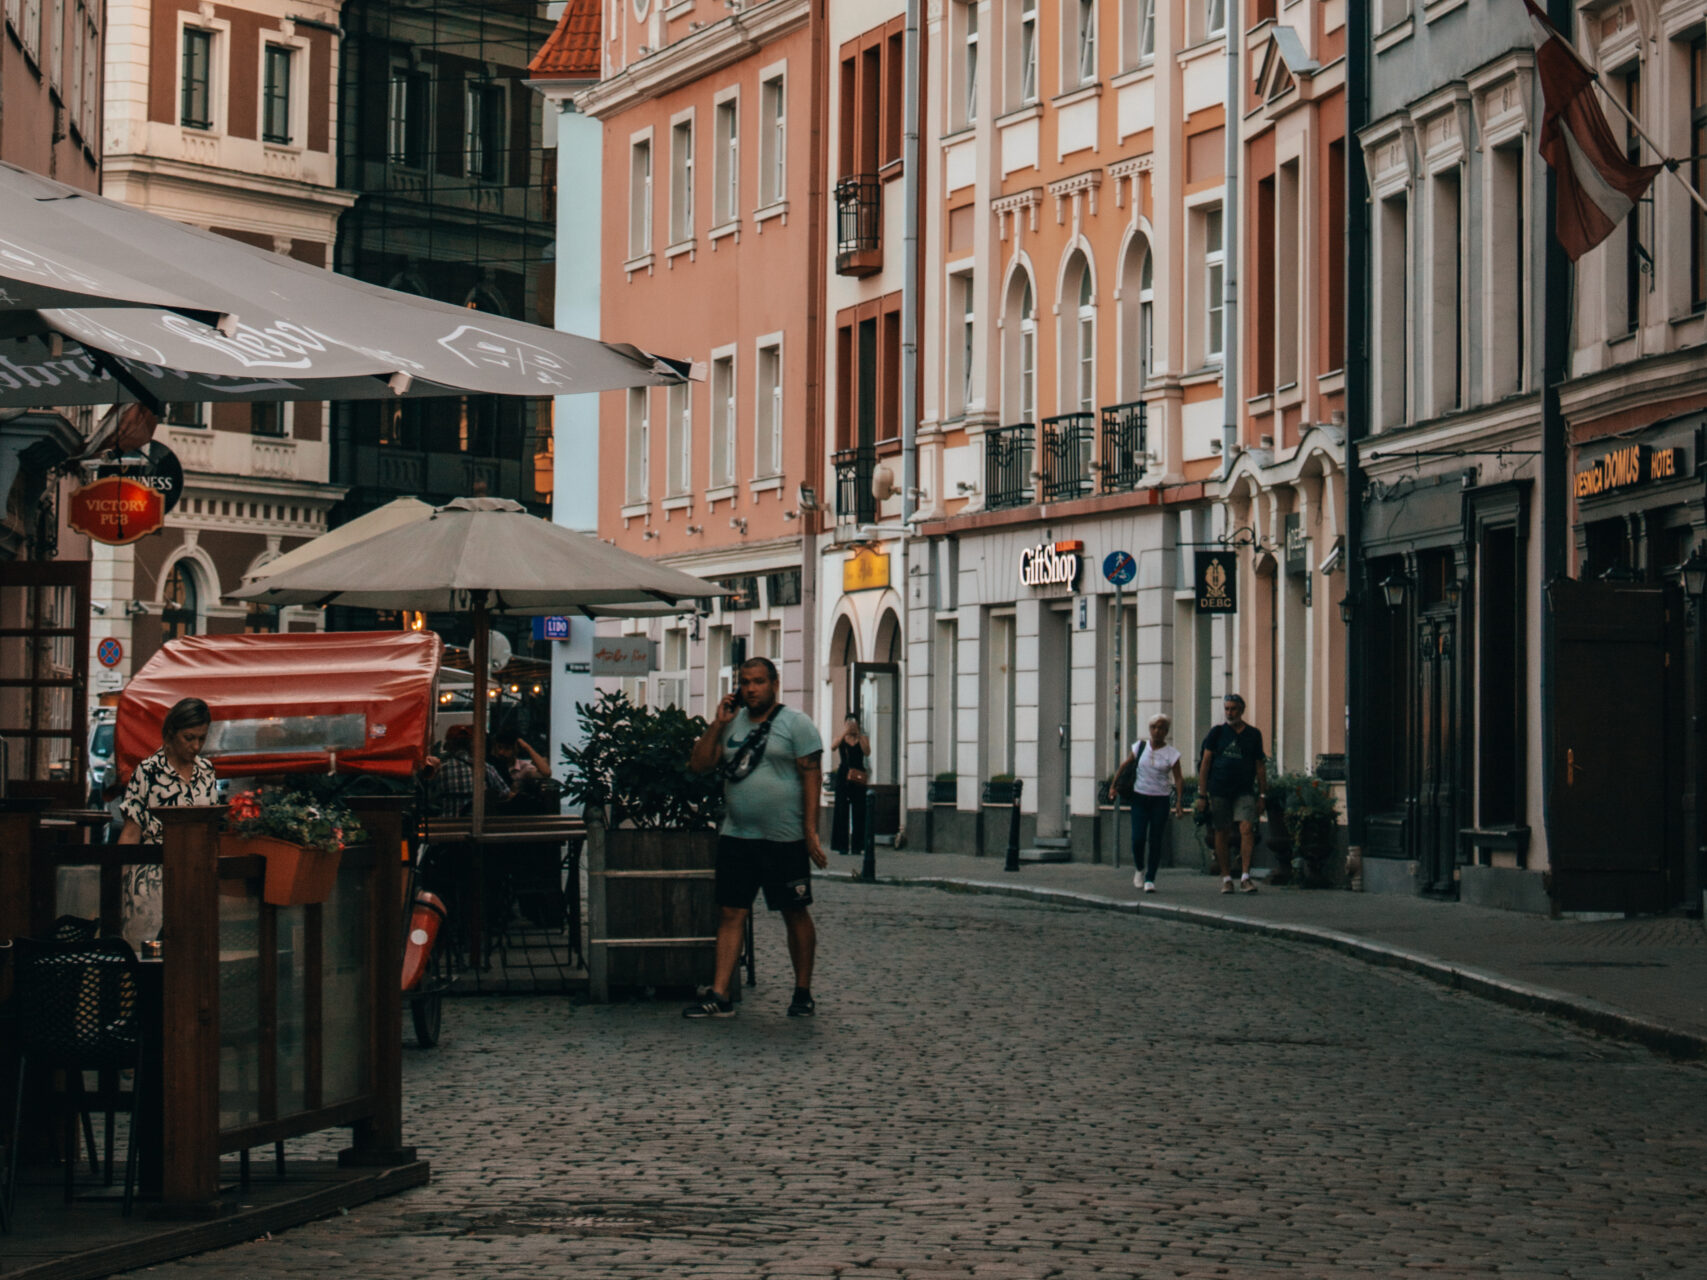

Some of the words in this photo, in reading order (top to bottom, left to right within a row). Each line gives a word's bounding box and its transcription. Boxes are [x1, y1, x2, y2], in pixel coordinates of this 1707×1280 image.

[1604, 443, 1640, 490] DOMUS
[1651, 448, 1676, 480] HOTEL
[86, 500, 148, 512] VICTORY
[101, 514, 129, 525] PUB
[1020, 542, 1077, 592] GiftShop
[548, 621, 568, 632] LIDO
